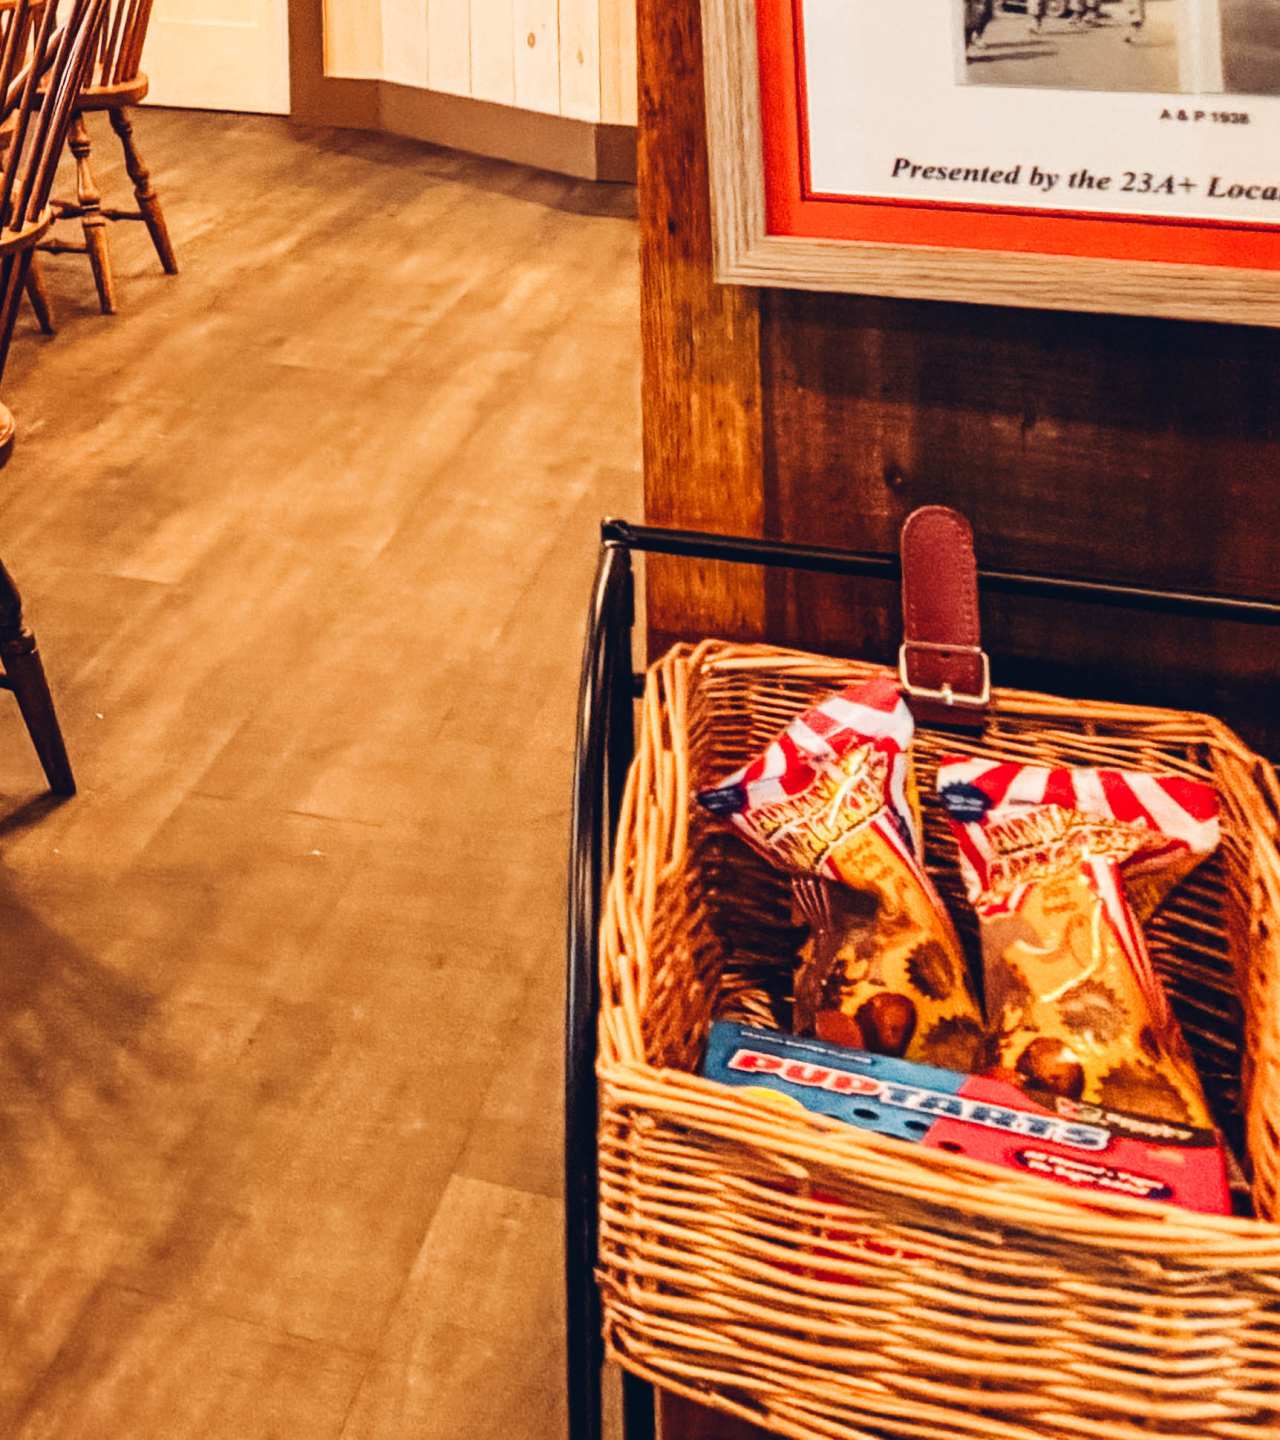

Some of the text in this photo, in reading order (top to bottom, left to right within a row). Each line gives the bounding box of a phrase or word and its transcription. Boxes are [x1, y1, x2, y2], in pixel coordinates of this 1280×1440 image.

[890, 157, 1280, 202] Presented by the 23A+ Loca
[728, 1048, 1112, 1152] PUPTARTS
